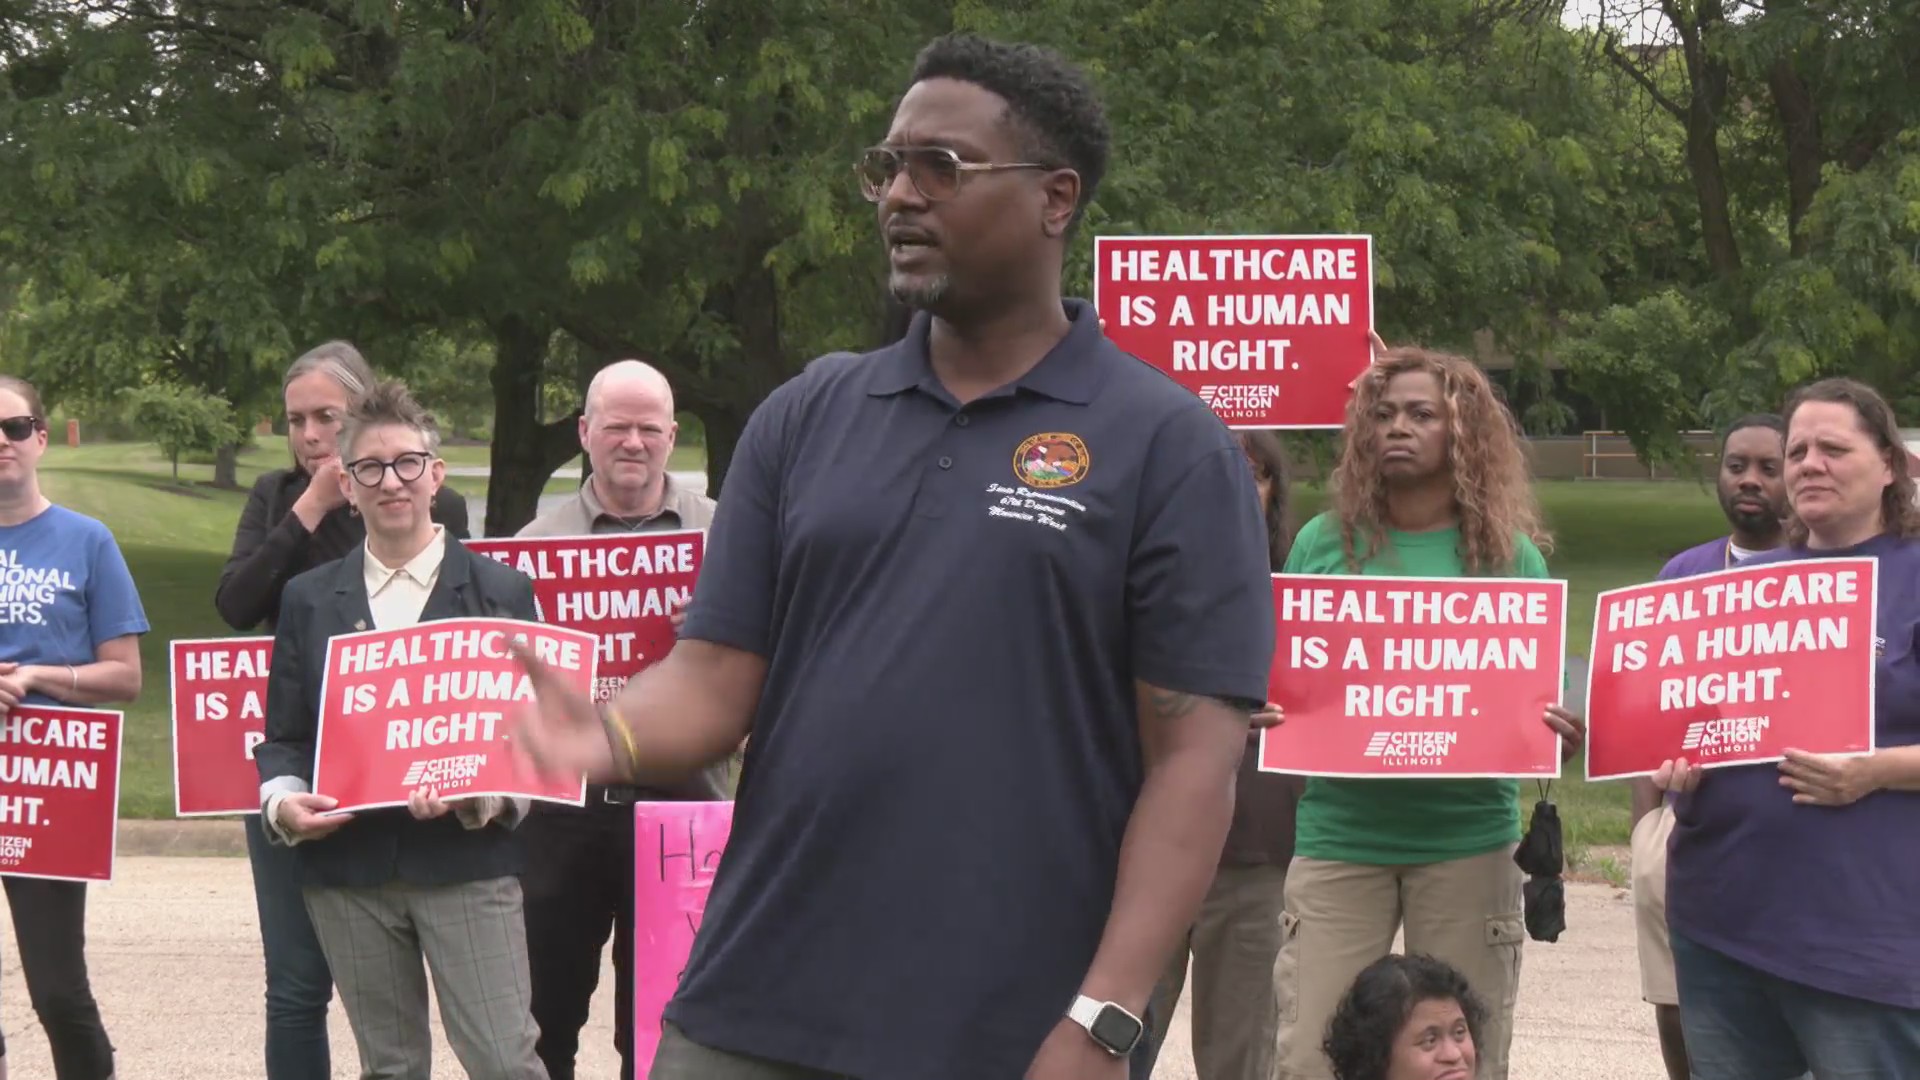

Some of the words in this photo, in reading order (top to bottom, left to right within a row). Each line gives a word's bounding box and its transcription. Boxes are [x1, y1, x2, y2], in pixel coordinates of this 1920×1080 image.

[1111, 249, 1357, 281] HEALTHCARE
[1120, 295, 1156, 326] IS
[1169, 295, 1195, 326] A
[1207, 293, 1350, 326] HUMAN
[1173, 339, 1299, 371] RIGHT.
[1211, 396, 1272, 409] ACTION
[1217, 384, 1279, 397] CITIZEN
[1216, 410, 1266, 418] LLINOIS
[481, 543, 694, 580] ALTHCARE
[1282, 588, 1548, 624] HEALTHCARE
[1608, 570, 1858, 632] HEALTHCARE
[1291, 636, 1329, 669] IS
[1342, 638, 1369, 670] A
[1383, 638, 1537, 670] HUMAN
[1612, 640, 1648, 673] IS
[1658, 635, 1684, 667] A
[1697, 616, 1849, 661] HUMAN
[186, 649, 270, 681] HEAL
[342, 683, 377, 715] IS
[386, 678, 410, 709] A
[422, 671, 536, 704] HUMA
[1345, 684, 1479, 717] RIGHT.
[1660, 667, 1790, 711] RIGHT.
[195, 692, 229, 721] IS
[240, 690, 264, 719] A
[1391, 731, 1457, 744] CITIZEN
[1701, 729, 1760, 747] ACTION
[1706, 716, 1770, 735] CITIZEN
[427, 754, 487, 772] CITIZEN
[1383, 757, 1442, 765] ILLINOIS
[1384, 743, 1448, 756] ACTION
[1700, 744, 1755, 757] ILLINOIS
[420, 763, 478, 784] ACTION
